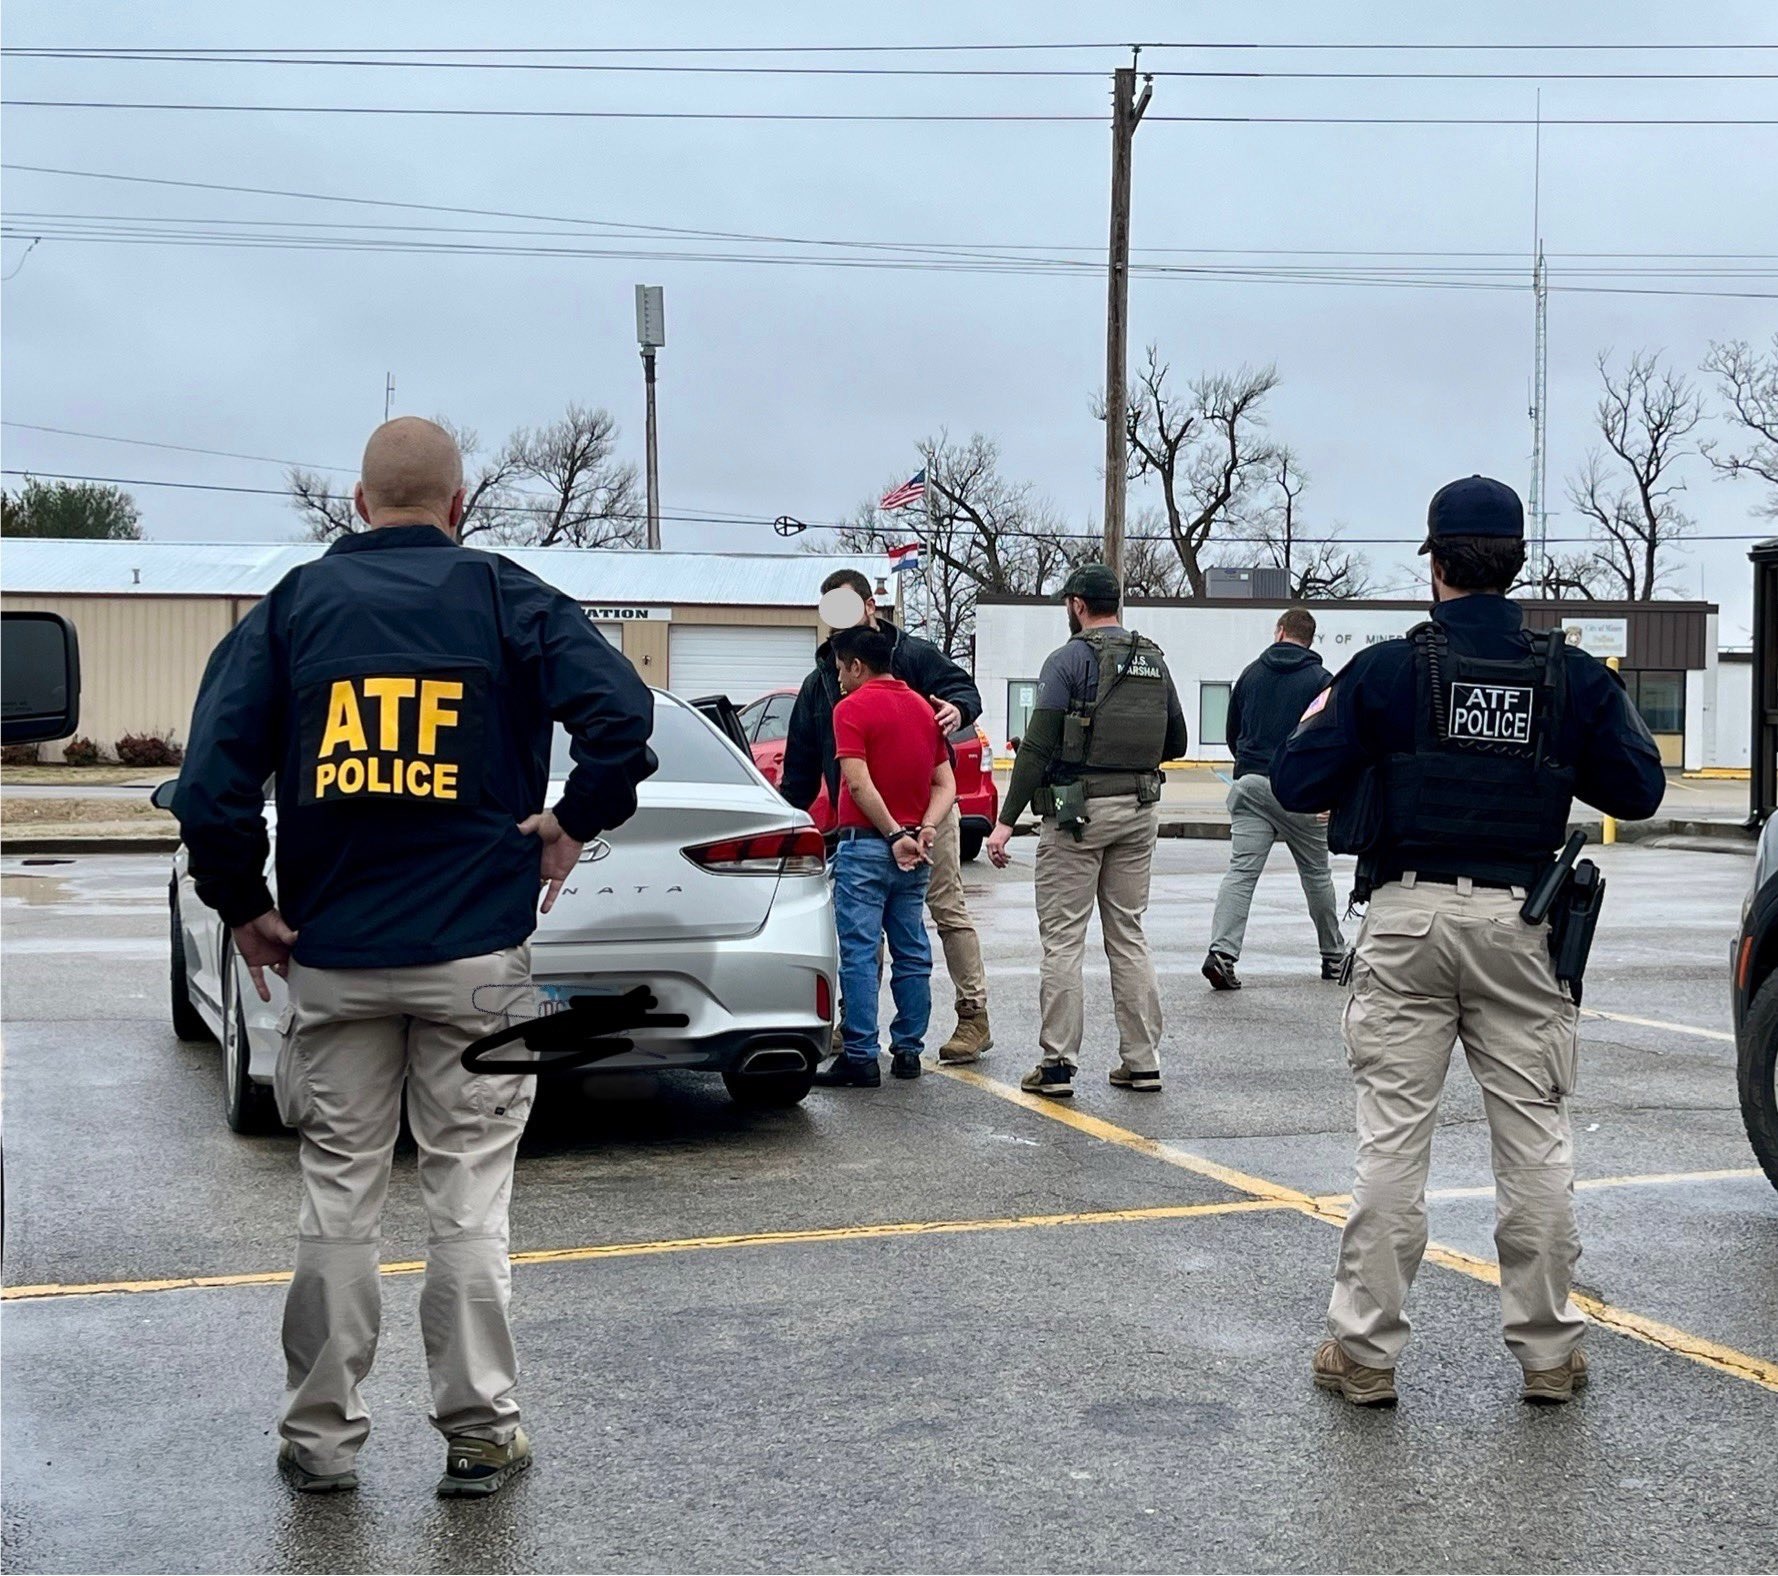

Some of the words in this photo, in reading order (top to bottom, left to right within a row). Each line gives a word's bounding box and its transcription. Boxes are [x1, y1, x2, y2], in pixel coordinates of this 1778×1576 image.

[583, 608, 649, 619] ATION
[1335, 634, 1352, 644] OF
[1466, 688, 1520, 710] ATF
[318, 678, 463, 759] ATF
[1454, 708, 1527, 737] POLICE
[316, 757, 458, 799] POLICE
[562, 885, 683, 895] NATA
